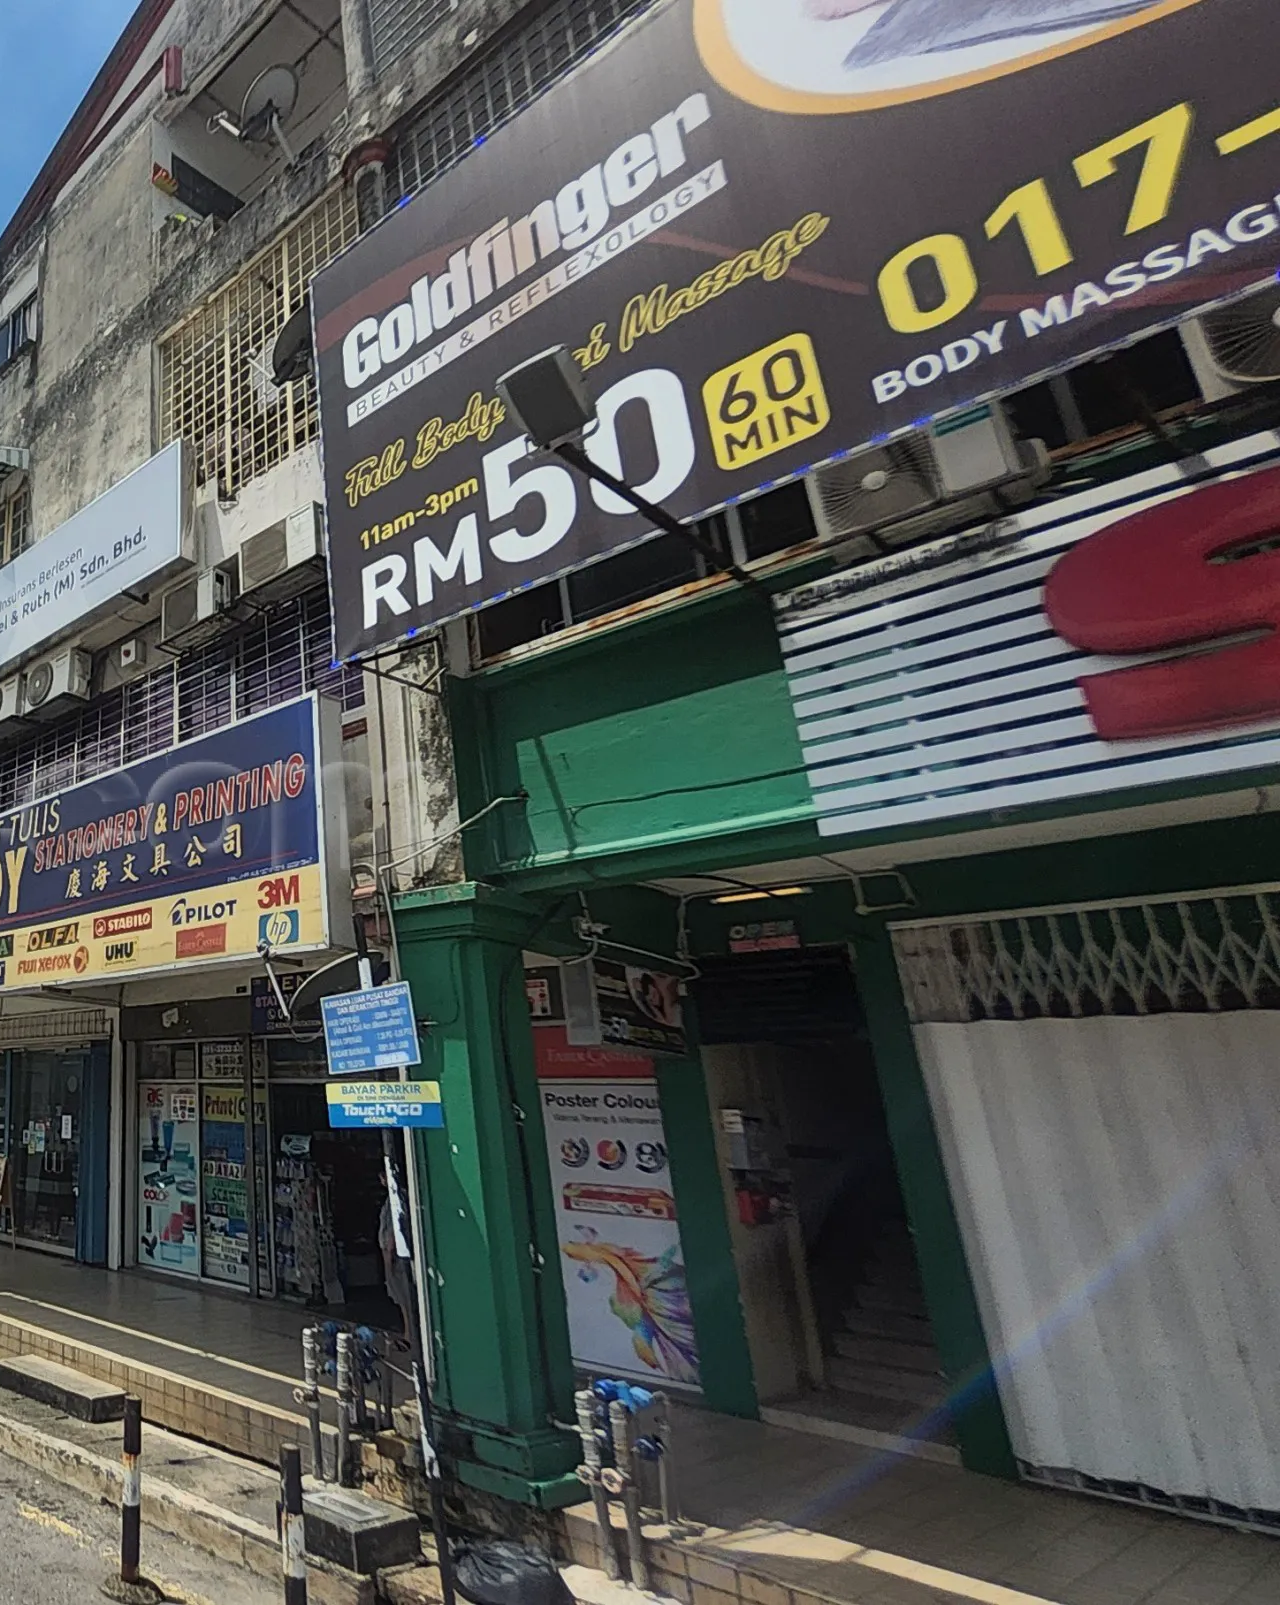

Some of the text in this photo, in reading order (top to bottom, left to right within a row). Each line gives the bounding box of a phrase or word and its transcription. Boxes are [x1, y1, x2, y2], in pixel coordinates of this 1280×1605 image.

[342, 92, 712, 390] Goldfinger
[354, 166, 718, 418] BEAUTY & REFLEXOLOGY
[870, 193, 1280, 404] BODY MASSAG
[345, 443, 408, 508] Full
[411, 390, 506, 471] Body
[619, 211, 831, 353] Massage
[719, 347, 806, 426] 60
[724, 394, 821, 464] MIN
[360, 476, 480, 551] 11am-3pm
[10, 612, 19, 626] &
[21, 591, 51, 619] Ruth
[53, 572, 75, 602] (M)
[79, 555, 109, 581] Sdn.
[113, 525, 148, 559] Bhd.
[38, 547, 83, 585] Berlesen
[10, 798, 61, 847] TULIS
[32, 752, 306, 874] STATIONERY & PRINTING
[185, 899, 238, 923] PILOT
[257, 874, 301, 910] 3M
[28, 923, 80, 950] OLFA
[107, 914, 151, 933] STABILO
[270, 911, 287, 946] hp
[17, 959, 37, 976] FUJI
[105, 941, 135, 961] UHU
[341, 1083, 422, 1095] BAYAR PARKIR
[544, 1092, 599, 1108] Poster
